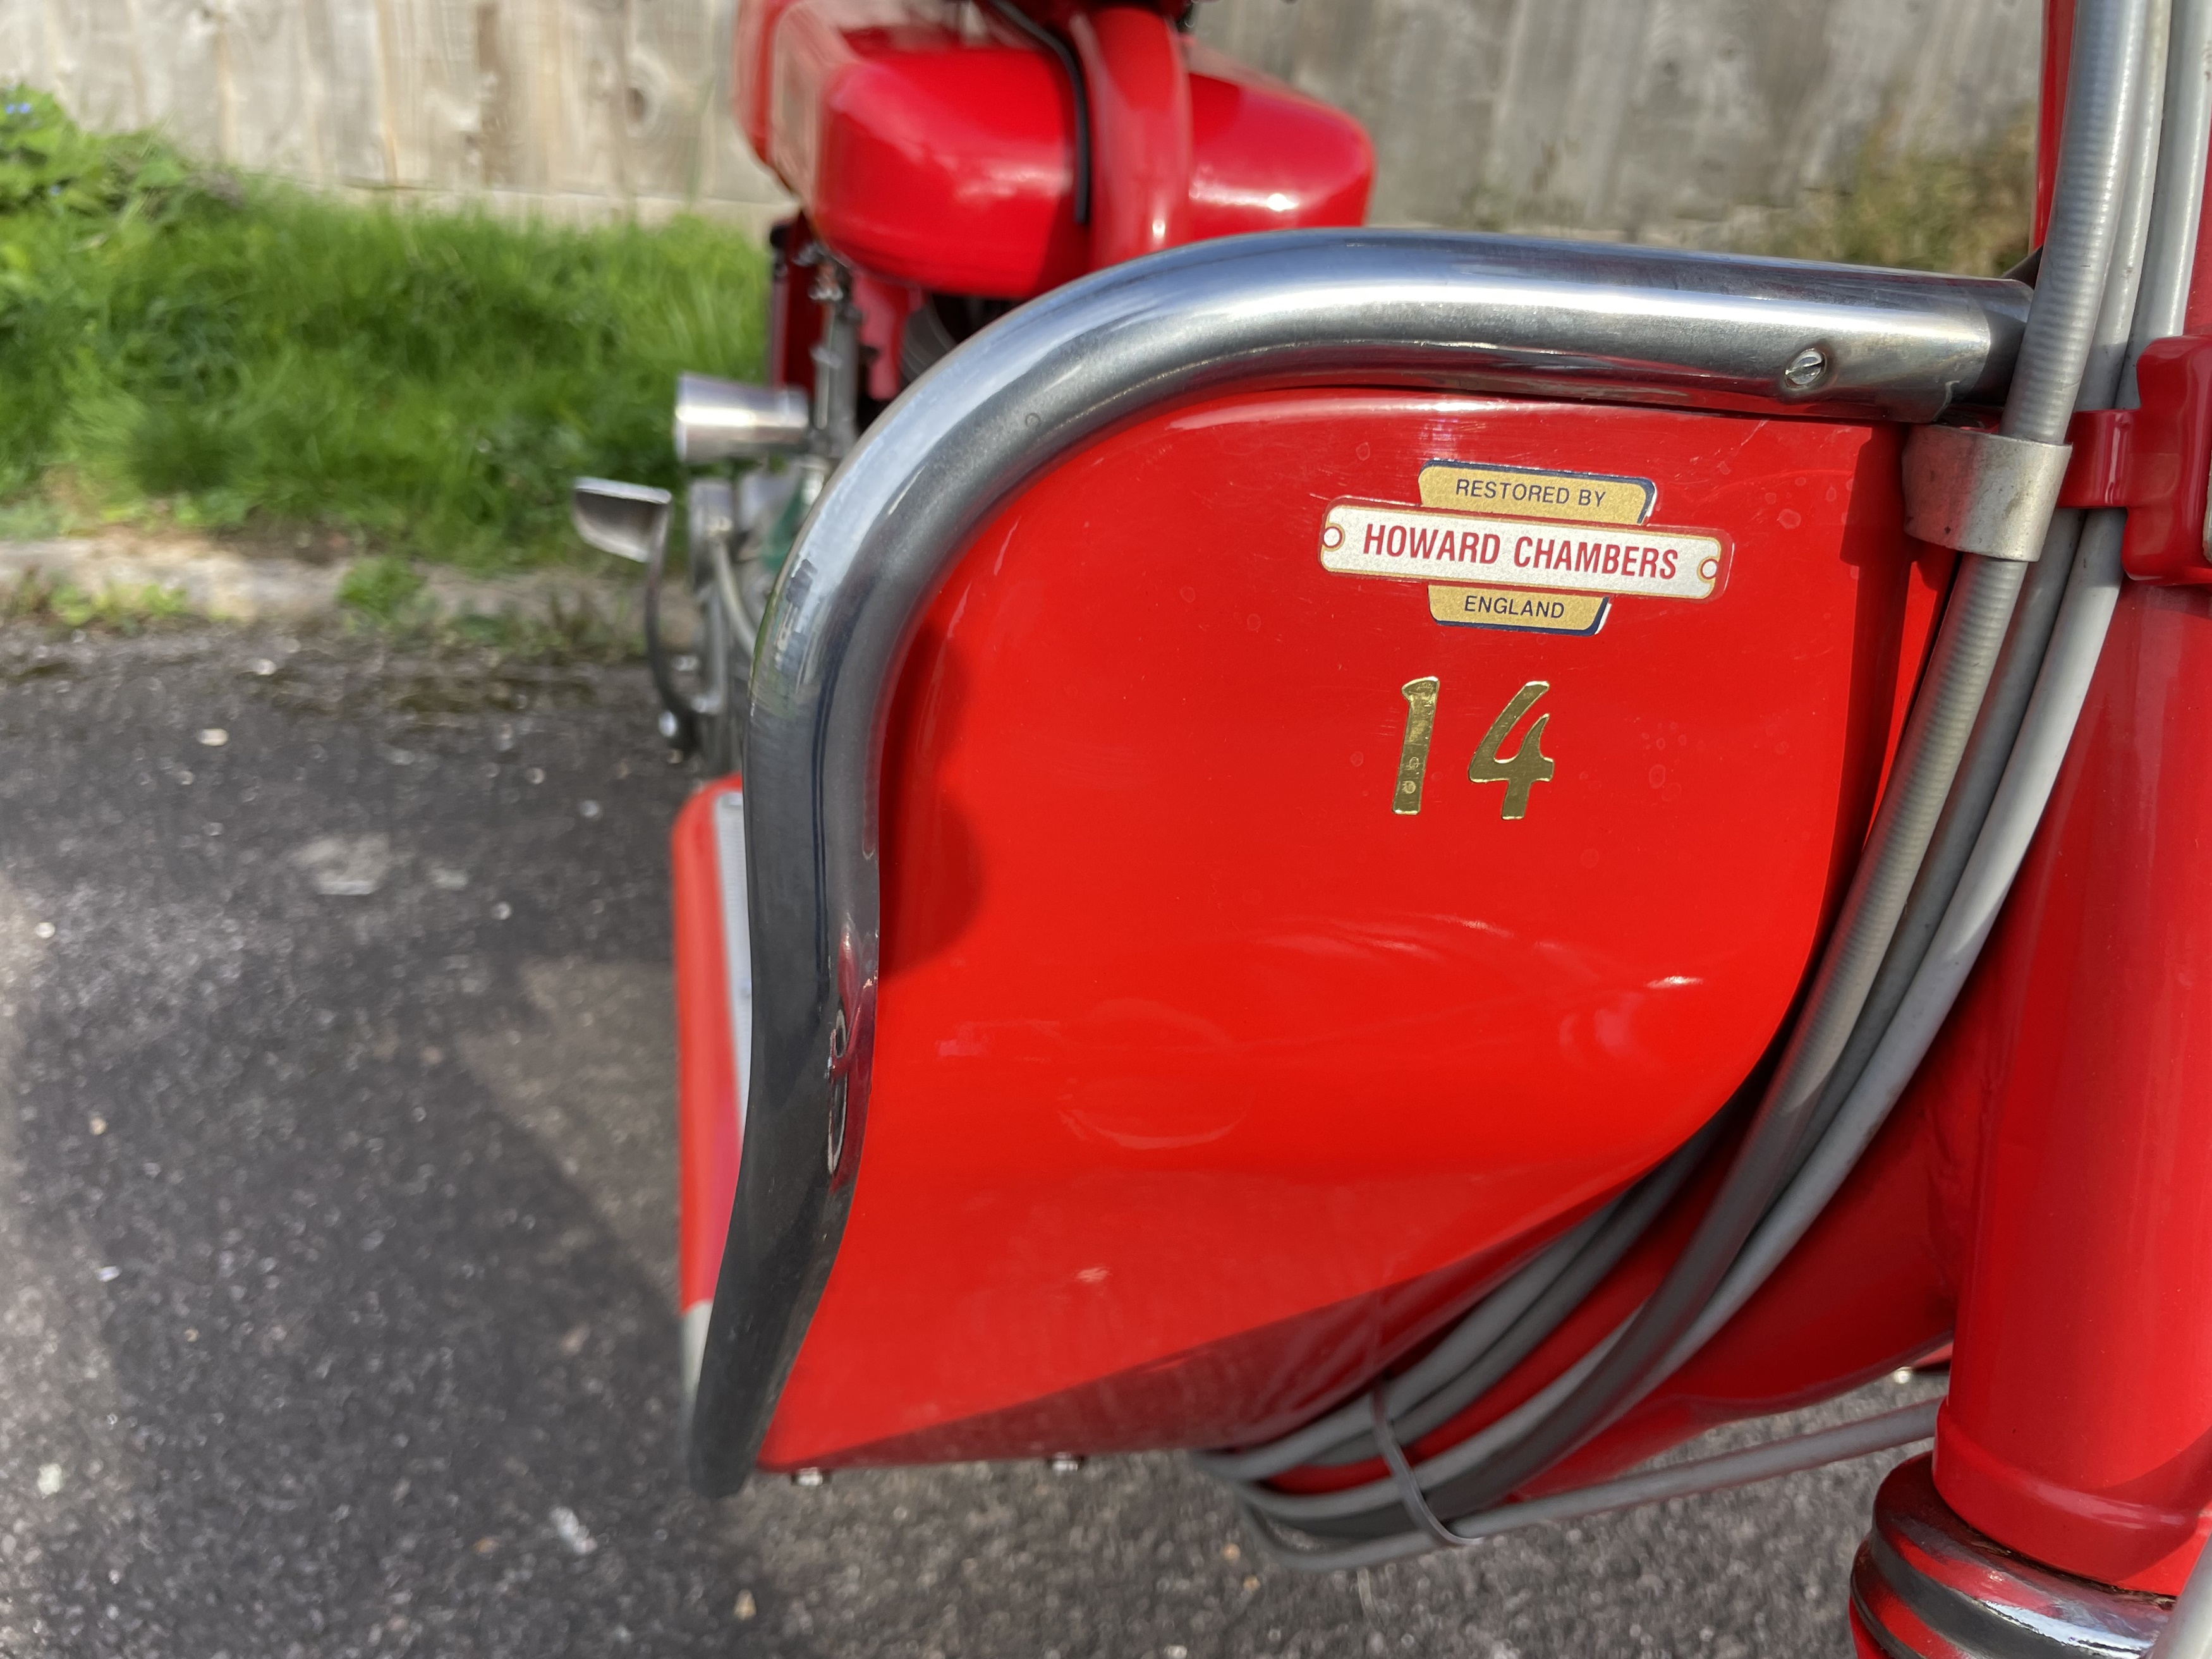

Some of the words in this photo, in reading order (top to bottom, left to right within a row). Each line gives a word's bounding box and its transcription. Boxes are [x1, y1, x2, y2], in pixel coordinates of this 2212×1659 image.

[1455, 478, 1570, 505] RESTORED
[1579, 490, 1607, 508] BY
[1363, 523, 1501, 565] HOWARD
[1514, 535, 1679, 580] CHAMBERS
[1464, 595, 1565, 620] ENGLAND
[1392, 676, 1555, 820] 14
